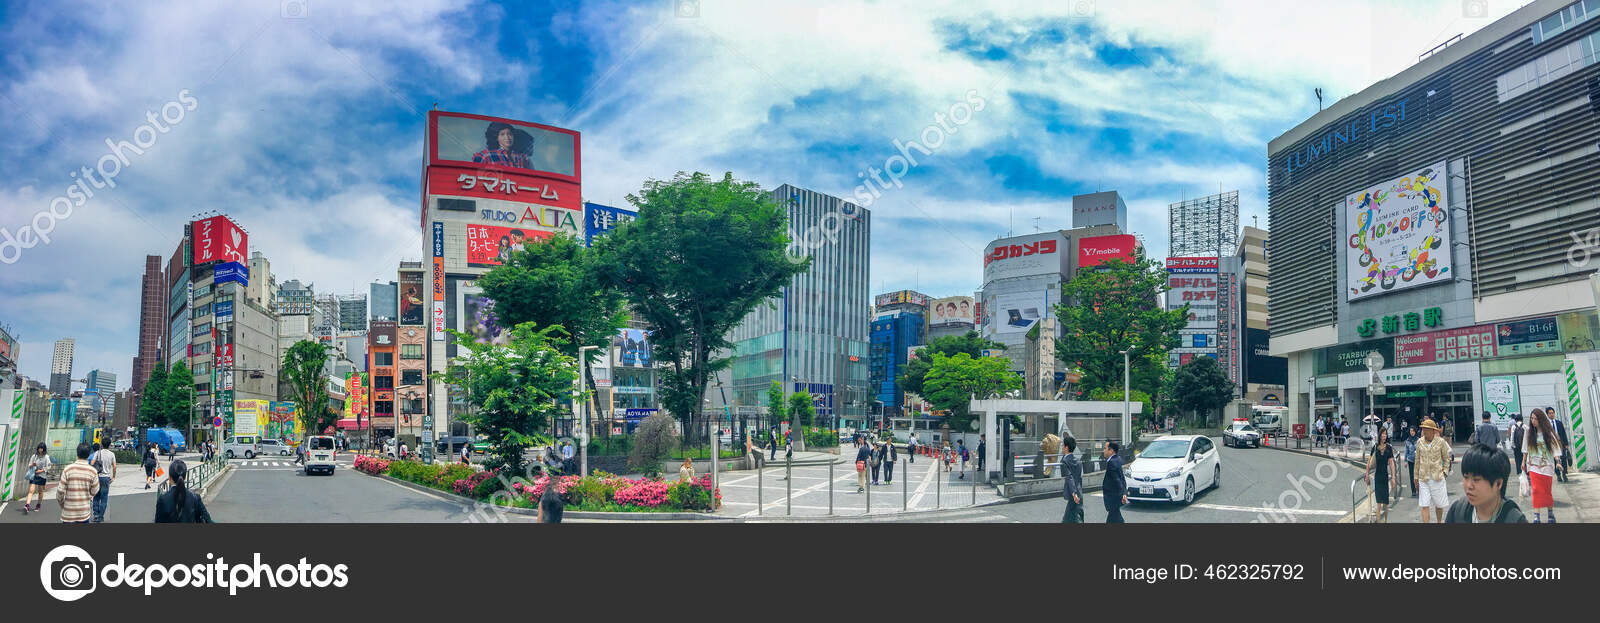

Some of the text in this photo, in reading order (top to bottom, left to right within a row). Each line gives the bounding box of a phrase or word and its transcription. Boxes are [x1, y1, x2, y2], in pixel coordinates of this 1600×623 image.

[1287, 98, 1409, 173] LUMINE EST
[457, 173, 559, 201] タマホーム
[1074, 204, 1116, 214] TAKANO
[1403, 205, 1419, 214] CARD
[481, 206, 577, 231] STUDIO ALTA
[468, 227, 489, 239] 日本
[202, 220, 213, 260] アイフル
[1170, 278, 1216, 288] ヨドバシ
[1182, 291, 1216, 301] カメラ
[1357, 318, 1376, 337] JR
[1381, 306, 1442, 334] 新宿駅
[1396, 335, 1428, 345] Welcome
[1397, 348, 1424, 358] LUMINE
